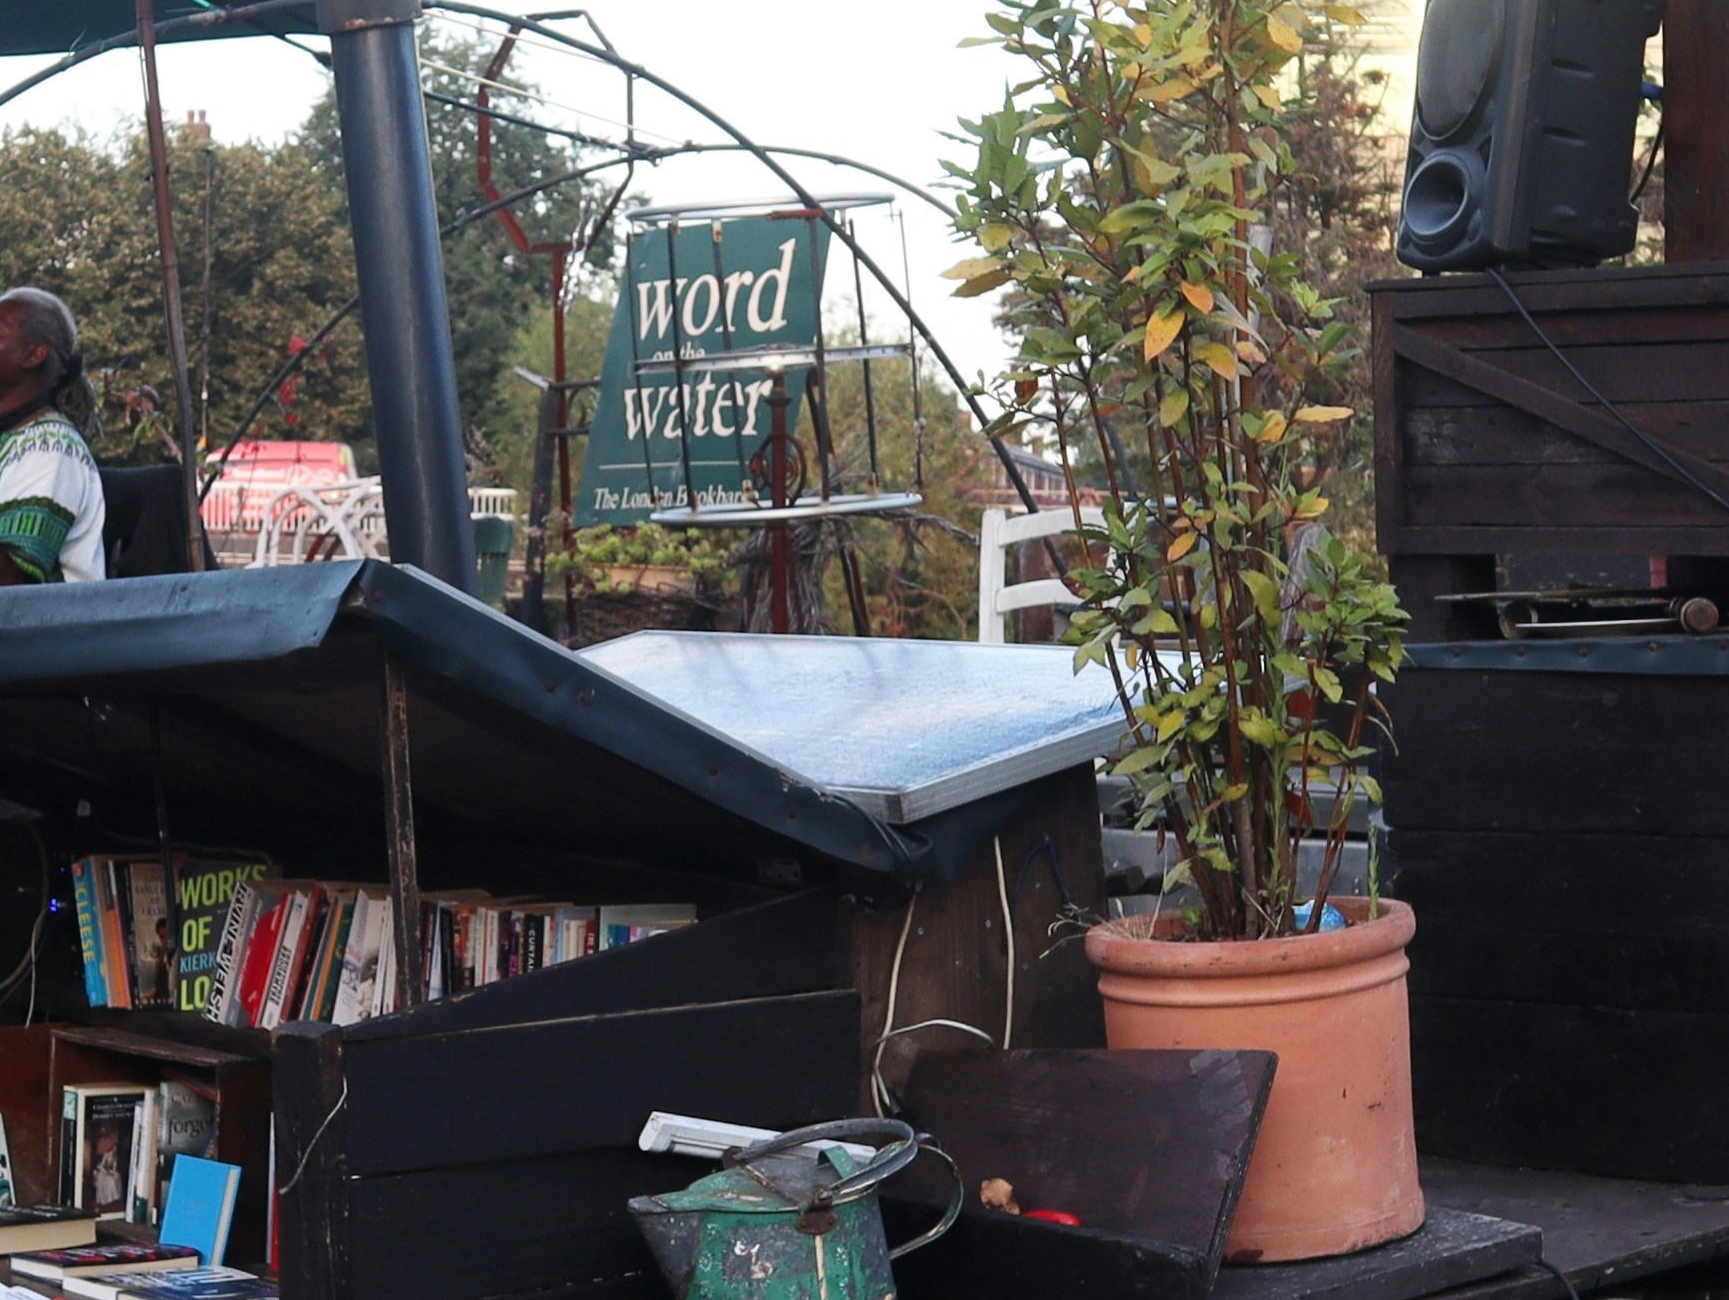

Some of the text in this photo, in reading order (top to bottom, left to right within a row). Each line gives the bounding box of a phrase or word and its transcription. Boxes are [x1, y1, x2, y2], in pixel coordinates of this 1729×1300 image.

[636, 237, 797, 341] word
[623, 370, 775, 442] water
[594, 484, 760, 510] The Londn Bokbare
[181, 864, 267, 911] WORKS
[75, 887, 96, 964] CLEESE
[182, 916, 213, 951] OF
[206, 952, 233, 1022] WELSH
